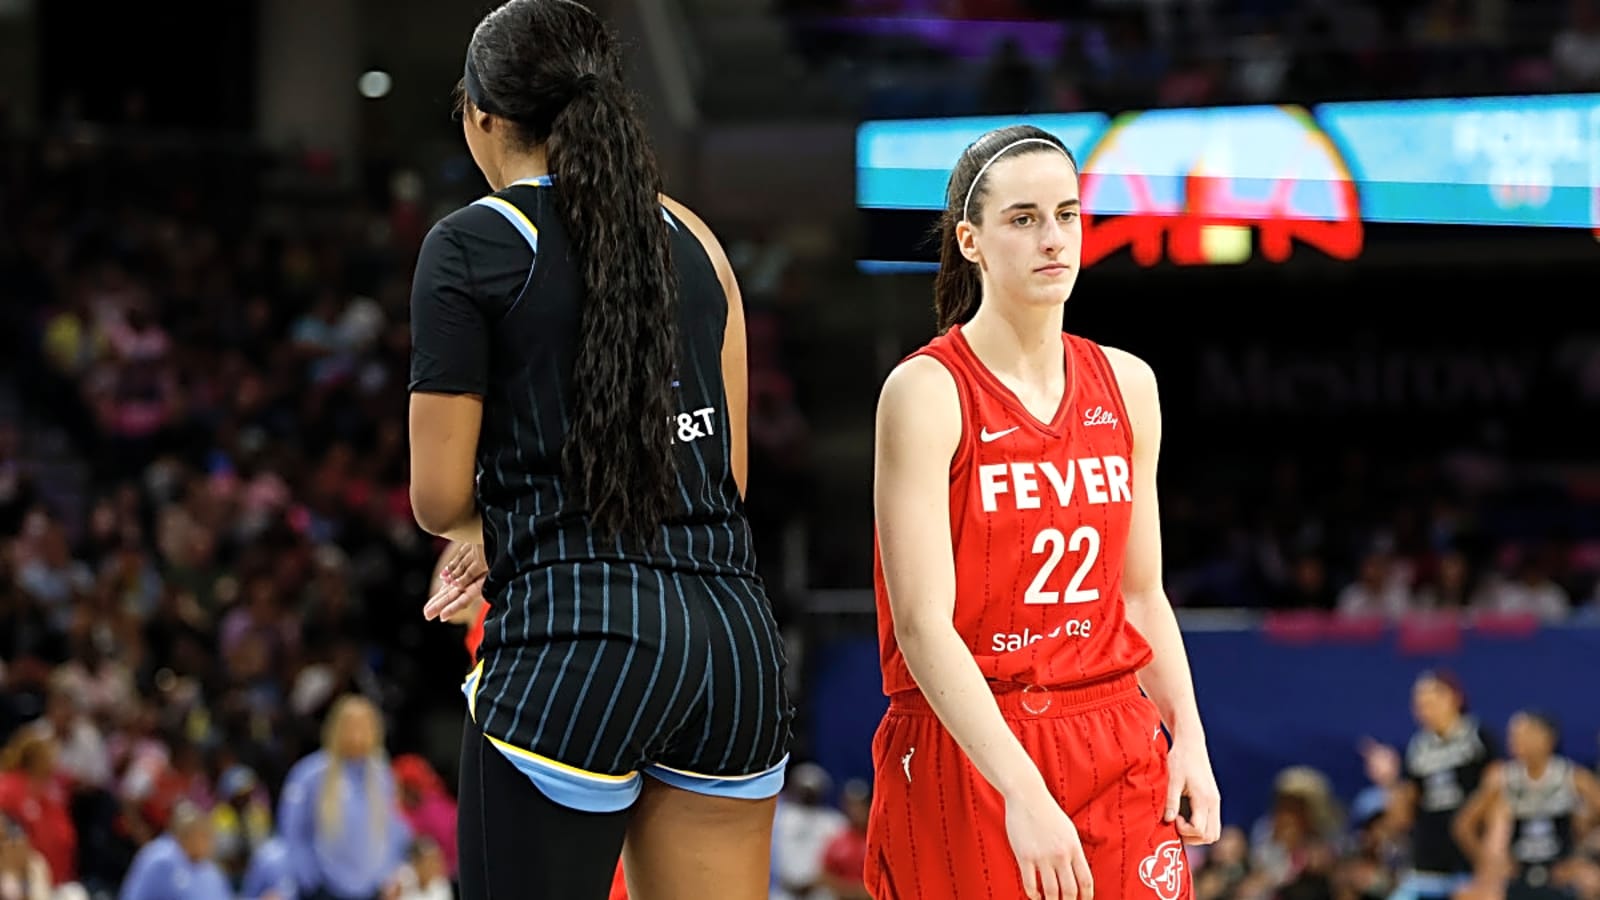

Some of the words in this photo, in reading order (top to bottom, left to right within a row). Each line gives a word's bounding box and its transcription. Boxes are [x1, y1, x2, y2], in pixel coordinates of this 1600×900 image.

[1083, 405, 1119, 430] Lilly
[978, 455, 1133, 513] FEVER
[1023, 526, 1101, 605] 22
